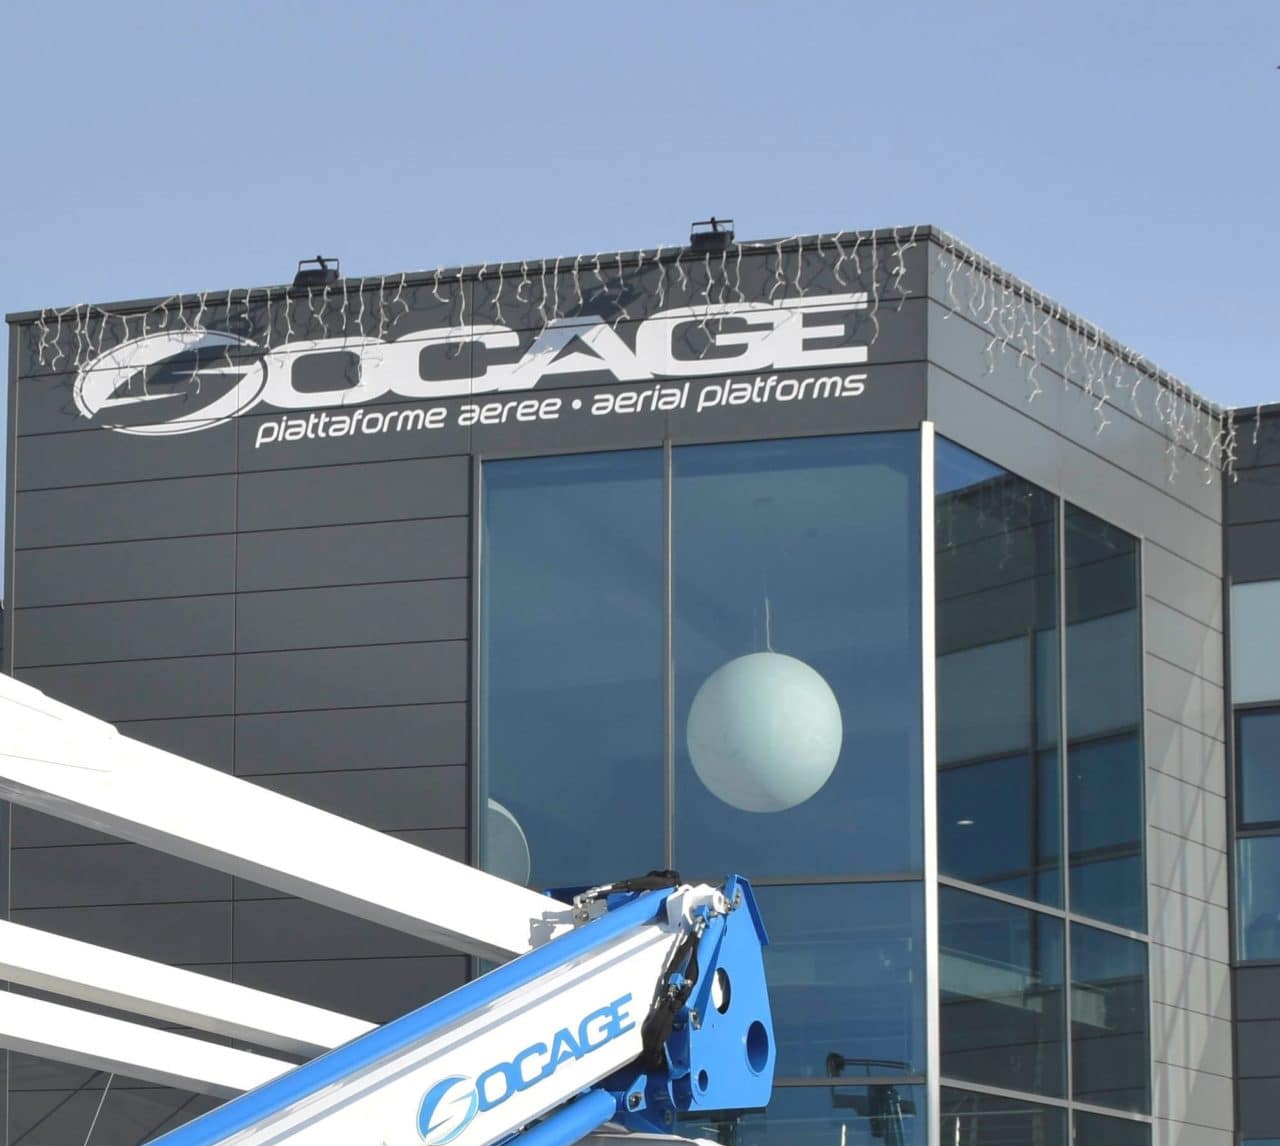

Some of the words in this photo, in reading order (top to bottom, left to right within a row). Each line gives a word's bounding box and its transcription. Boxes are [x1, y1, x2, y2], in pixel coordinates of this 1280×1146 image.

[72, 292, 868, 435] SOCAGE
[255, 404, 446, 449] piattaforme
[457, 399, 561, 426] aeree
[591, 382, 691, 416] aerial
[696, 373, 868, 413] platforms
[416, 992, 636, 1146] SOCAGE
